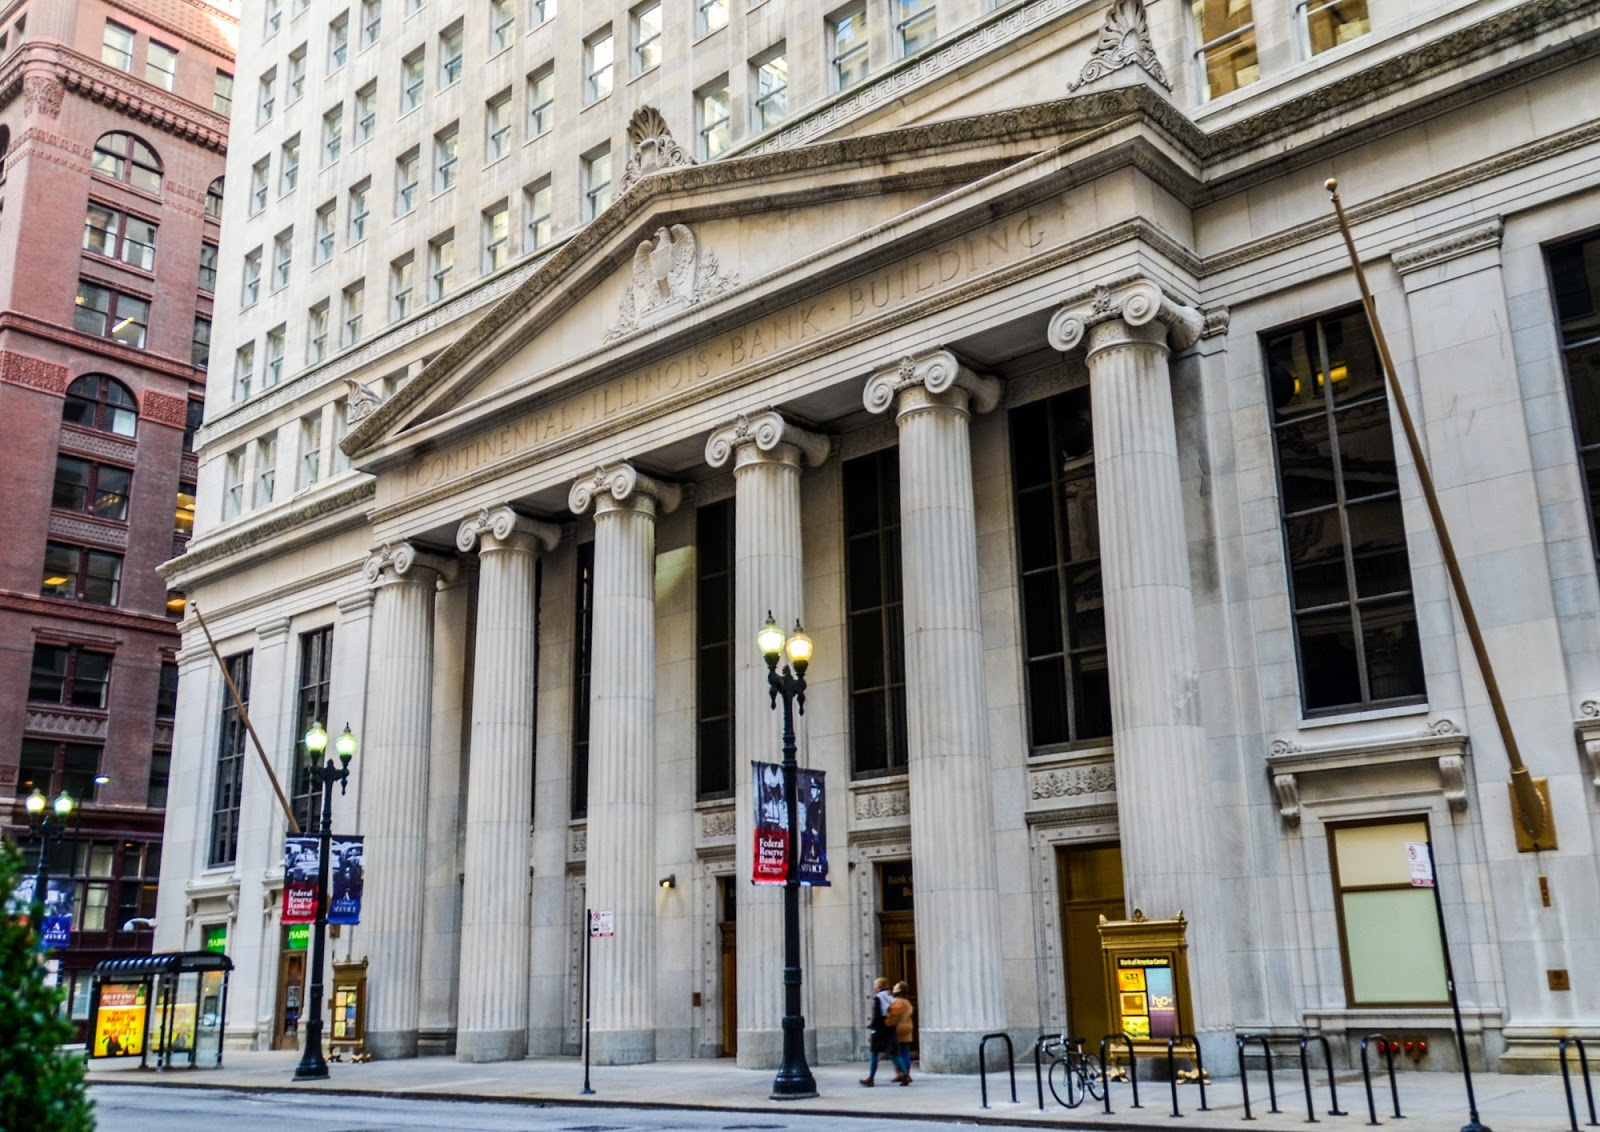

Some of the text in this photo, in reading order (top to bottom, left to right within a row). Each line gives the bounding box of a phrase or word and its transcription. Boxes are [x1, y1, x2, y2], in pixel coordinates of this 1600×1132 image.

[416, 213, 1046, 486] CONTINENTAL ILLINOIS BANK BUILDING
[760, 838, 784, 848] Federal
[760, 848, 784, 856] Reserve
[759, 855, 776, 864] Bank
[758, 864, 782, 874] Chicago
[289, 889, 313, 897] Federal
